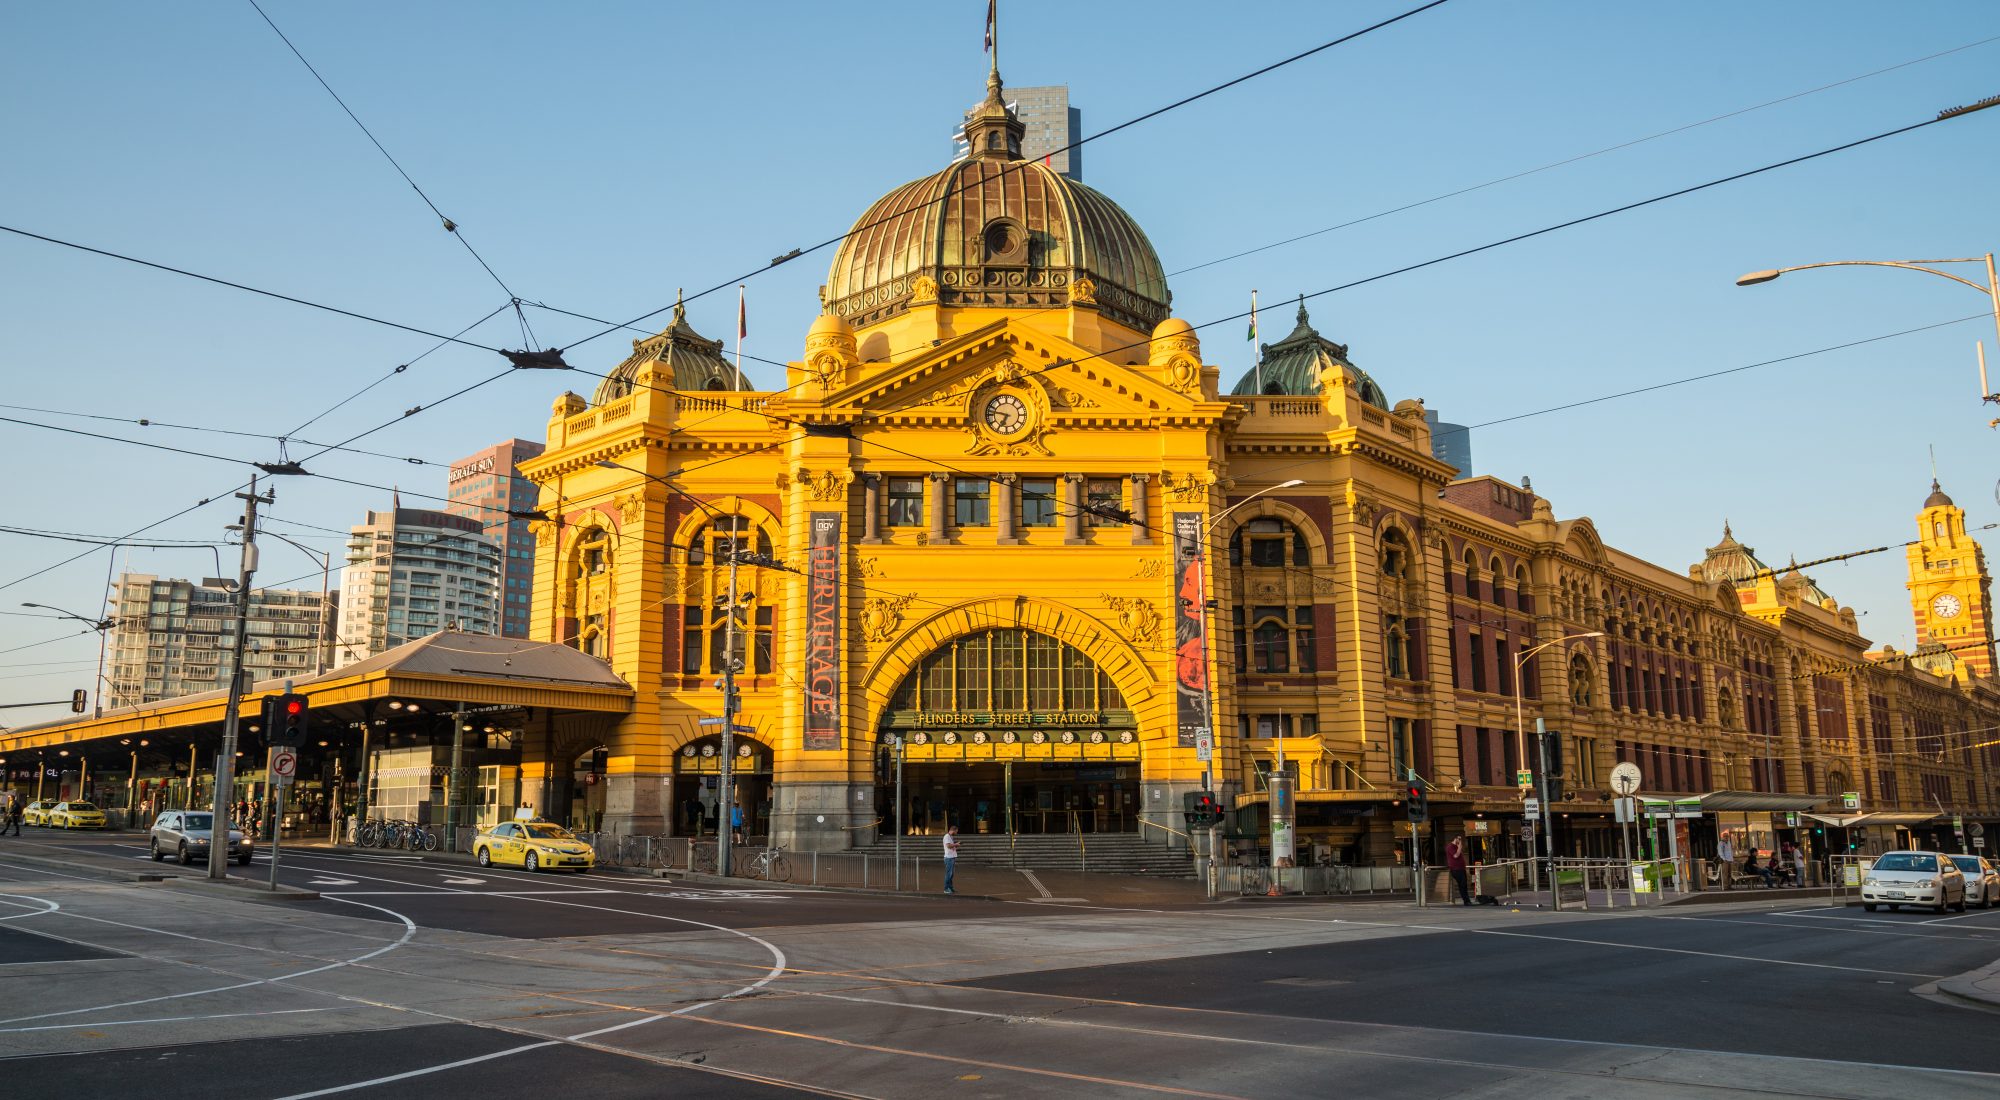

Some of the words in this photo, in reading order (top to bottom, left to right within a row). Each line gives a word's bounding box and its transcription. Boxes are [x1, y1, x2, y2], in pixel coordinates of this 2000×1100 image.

[448, 464, 477, 482] HERALD
[478, 455, 495, 472] SUN
[818, 521, 834, 531] ngv
[811, 543, 835, 714] HERMITAGE
[919, 714, 975, 724] FLINDERS
[989, 713, 1032, 724] STREET
[1046, 713, 1098, 723] STATION
